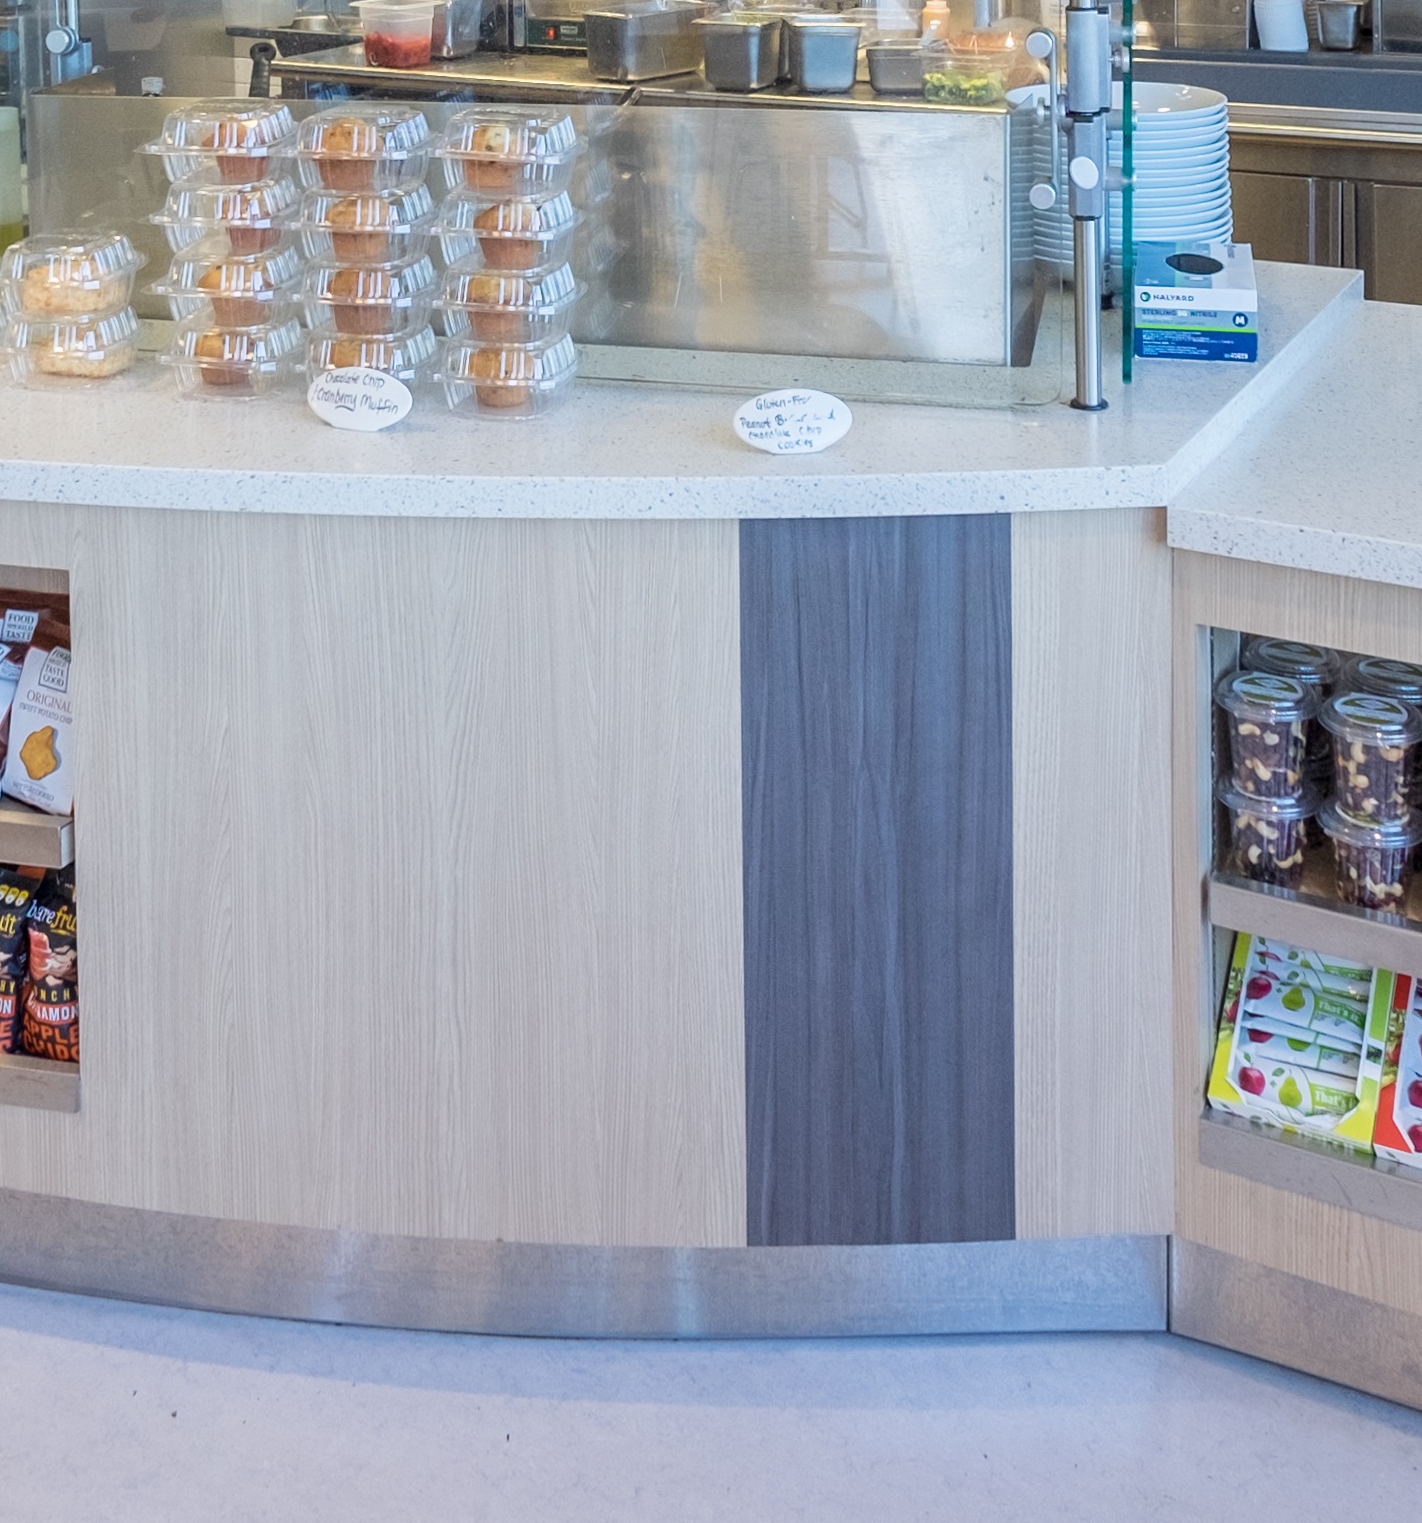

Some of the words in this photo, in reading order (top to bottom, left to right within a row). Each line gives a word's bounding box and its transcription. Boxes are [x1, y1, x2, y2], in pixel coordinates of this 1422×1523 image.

[1153, 294, 1194, 302] HALYARD
[1235, 315, 1246, 325] M
[362, 374, 386, 391] Chip
[360, 394, 399, 414] Muffin
[8, 613, 35, 625] FOOD
[45, 664, 65, 677] TASTE
[42, 674, 65, 687] GOOD
[27, 690, 73, 713] ORIGINAL
[26, 900, 76, 933] barefru
[1318, 999, 1350, 1019] That's
[1315, 1089, 1346, 1108] That's
